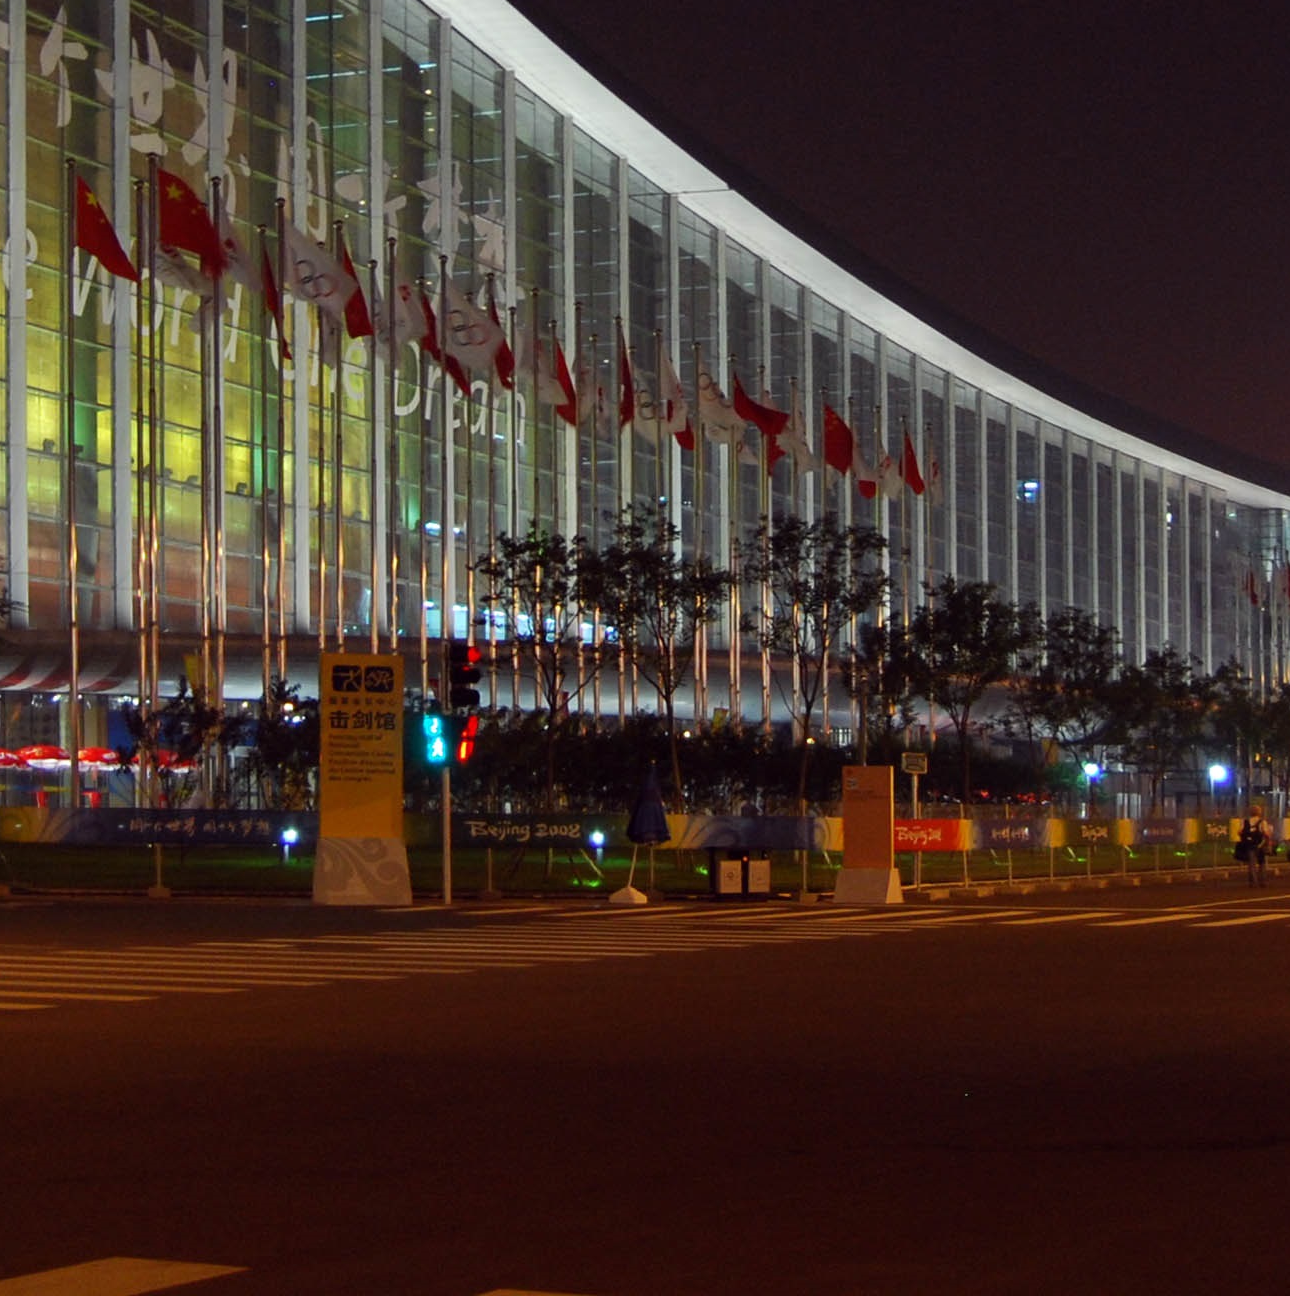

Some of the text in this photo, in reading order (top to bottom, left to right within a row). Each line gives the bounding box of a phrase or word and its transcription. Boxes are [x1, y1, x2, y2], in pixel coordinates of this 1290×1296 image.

[329, 709, 397, 730] 击剑馆
[463, 820, 582, 842] Beijing 2008
